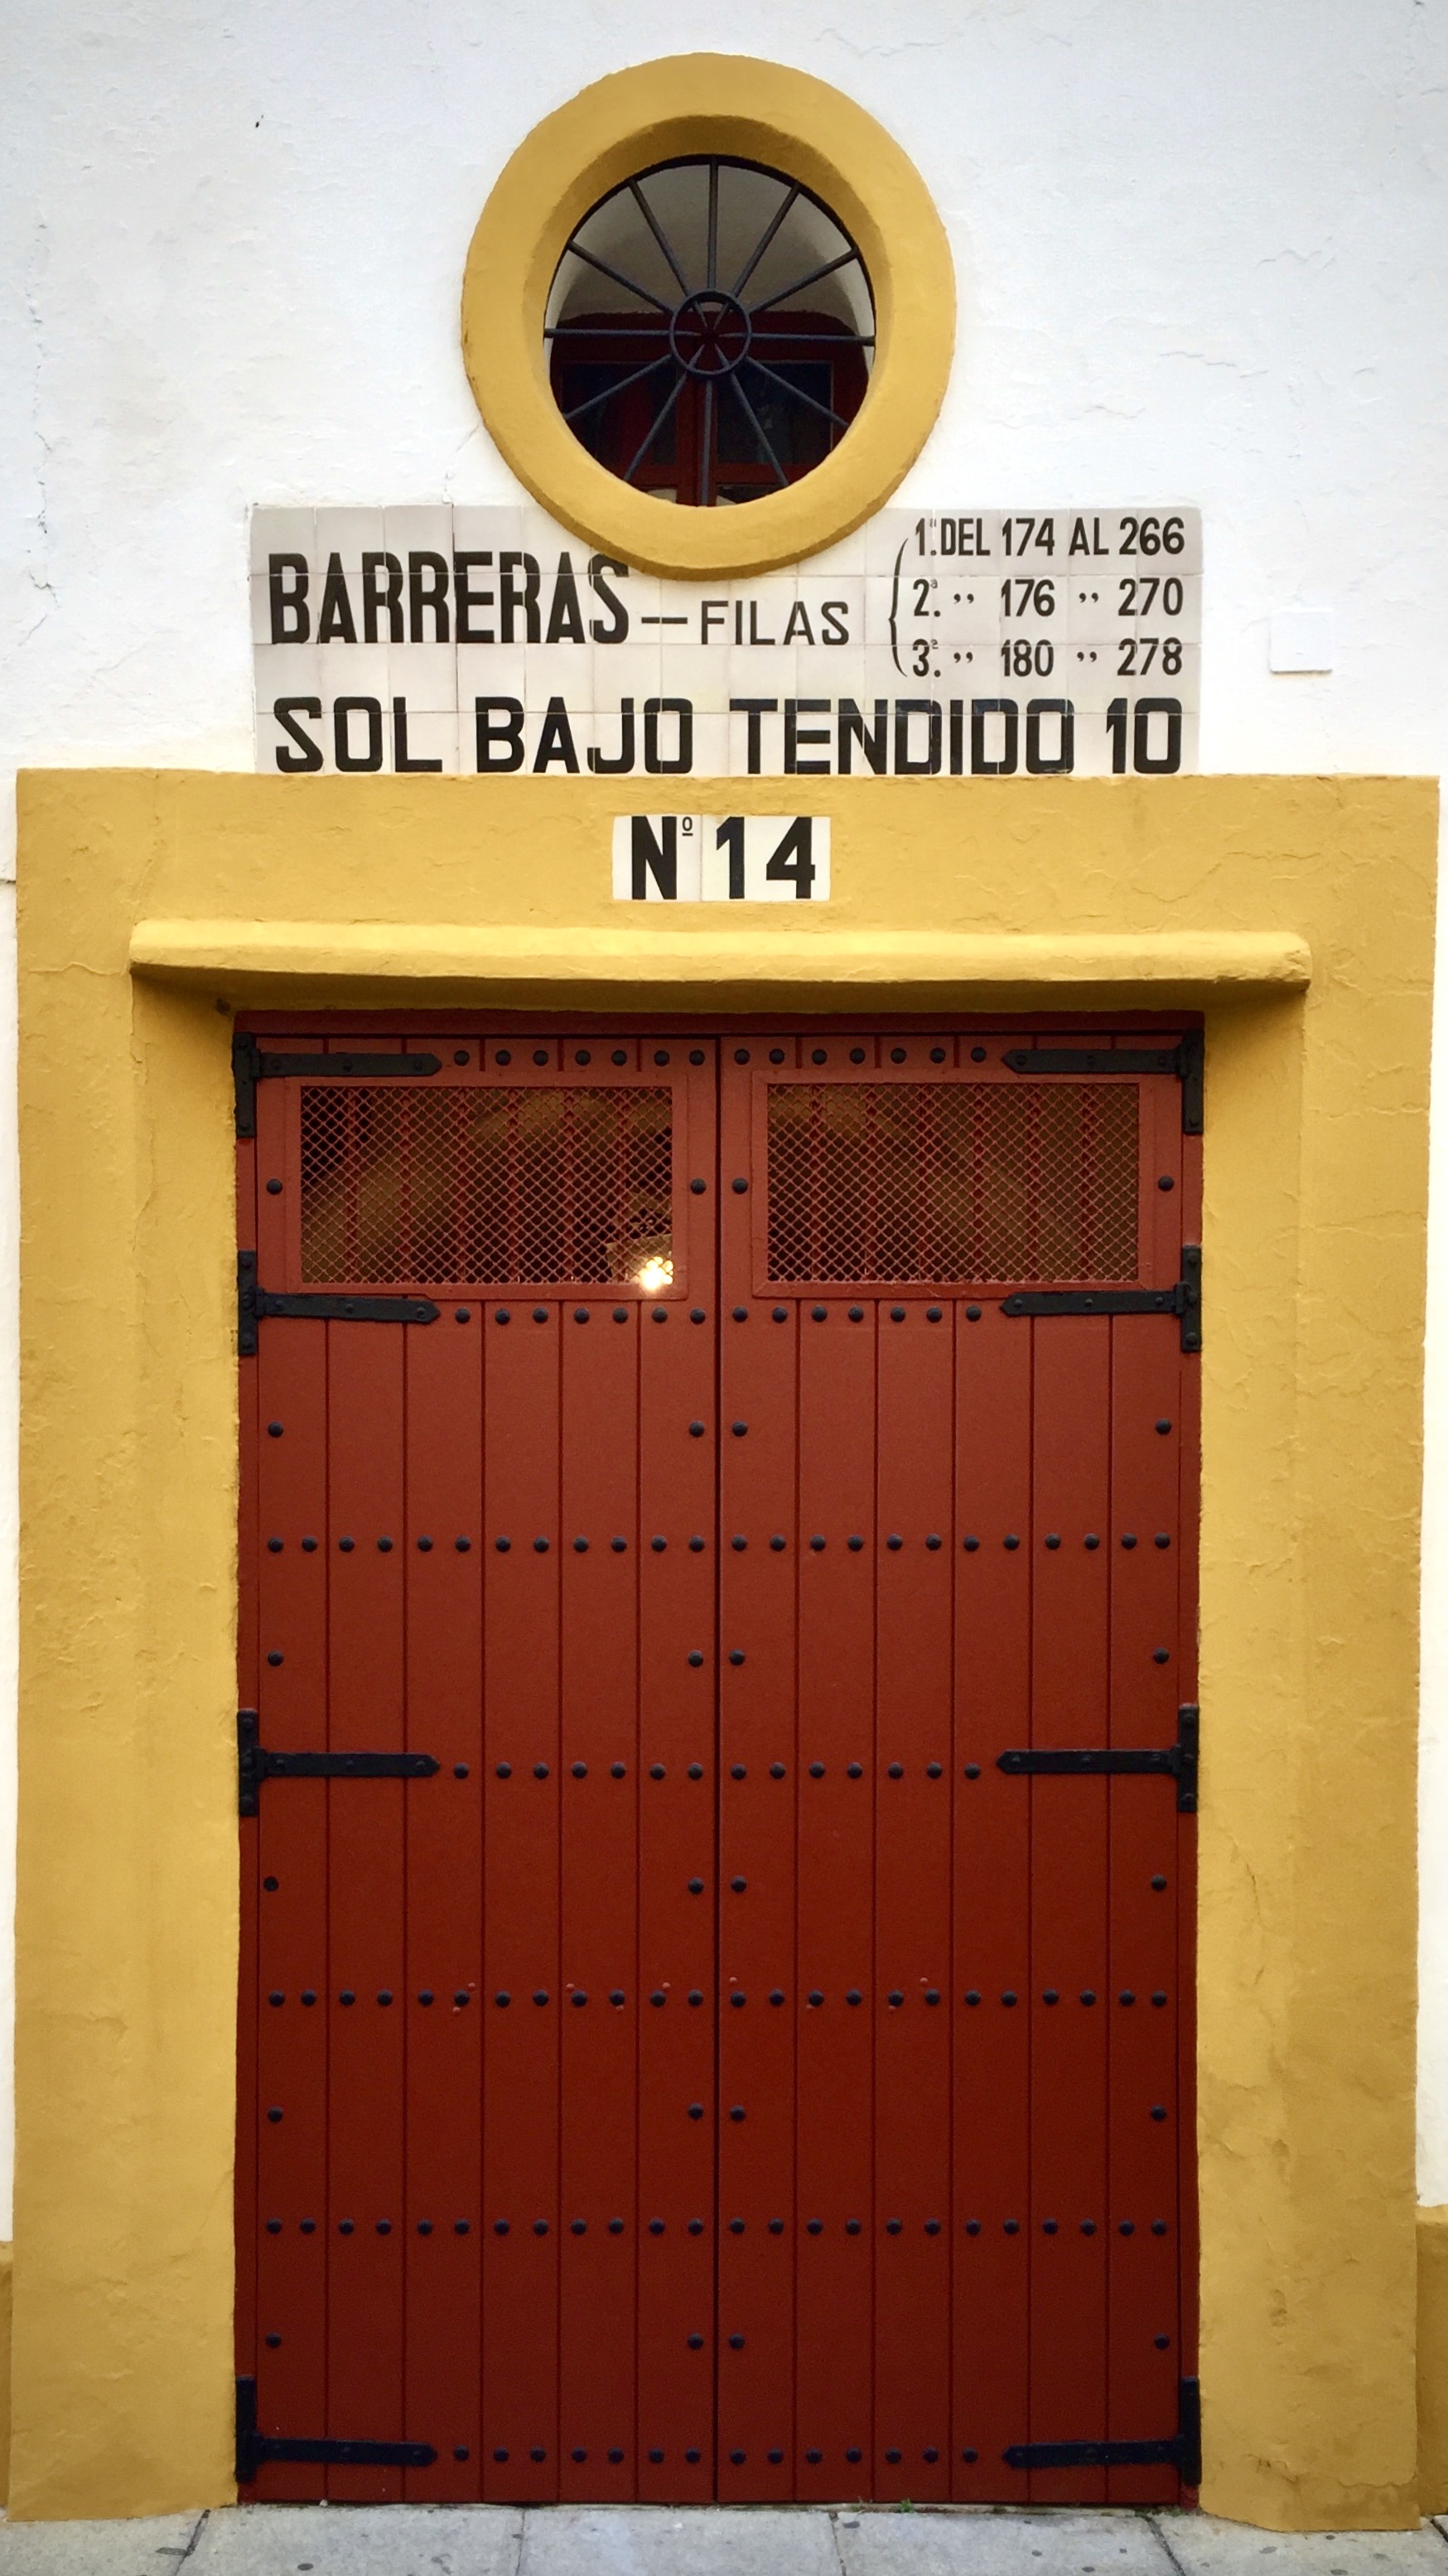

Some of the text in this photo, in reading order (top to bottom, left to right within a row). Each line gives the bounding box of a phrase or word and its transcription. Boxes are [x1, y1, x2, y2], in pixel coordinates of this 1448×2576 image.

[940, 518, 991, 556] DEL
[1002, 518, 1055, 556] 174
[1069, 517, 1110, 556] AL
[1119, 516, 1185, 556] 266
[268, 551, 630, 645] BARRERAS
[701, 600, 850, 645] FILAS
[1001, 578, 1055, 617] 176
[1118, 577, 1185, 616] 270
[1001, 639, 1055, 677] 180
[1117, 637, 1183, 676] 278
[273, 696, 1183, 776] SOL BAJO TENDIDO 10
[716, 816, 816, 900] 14
